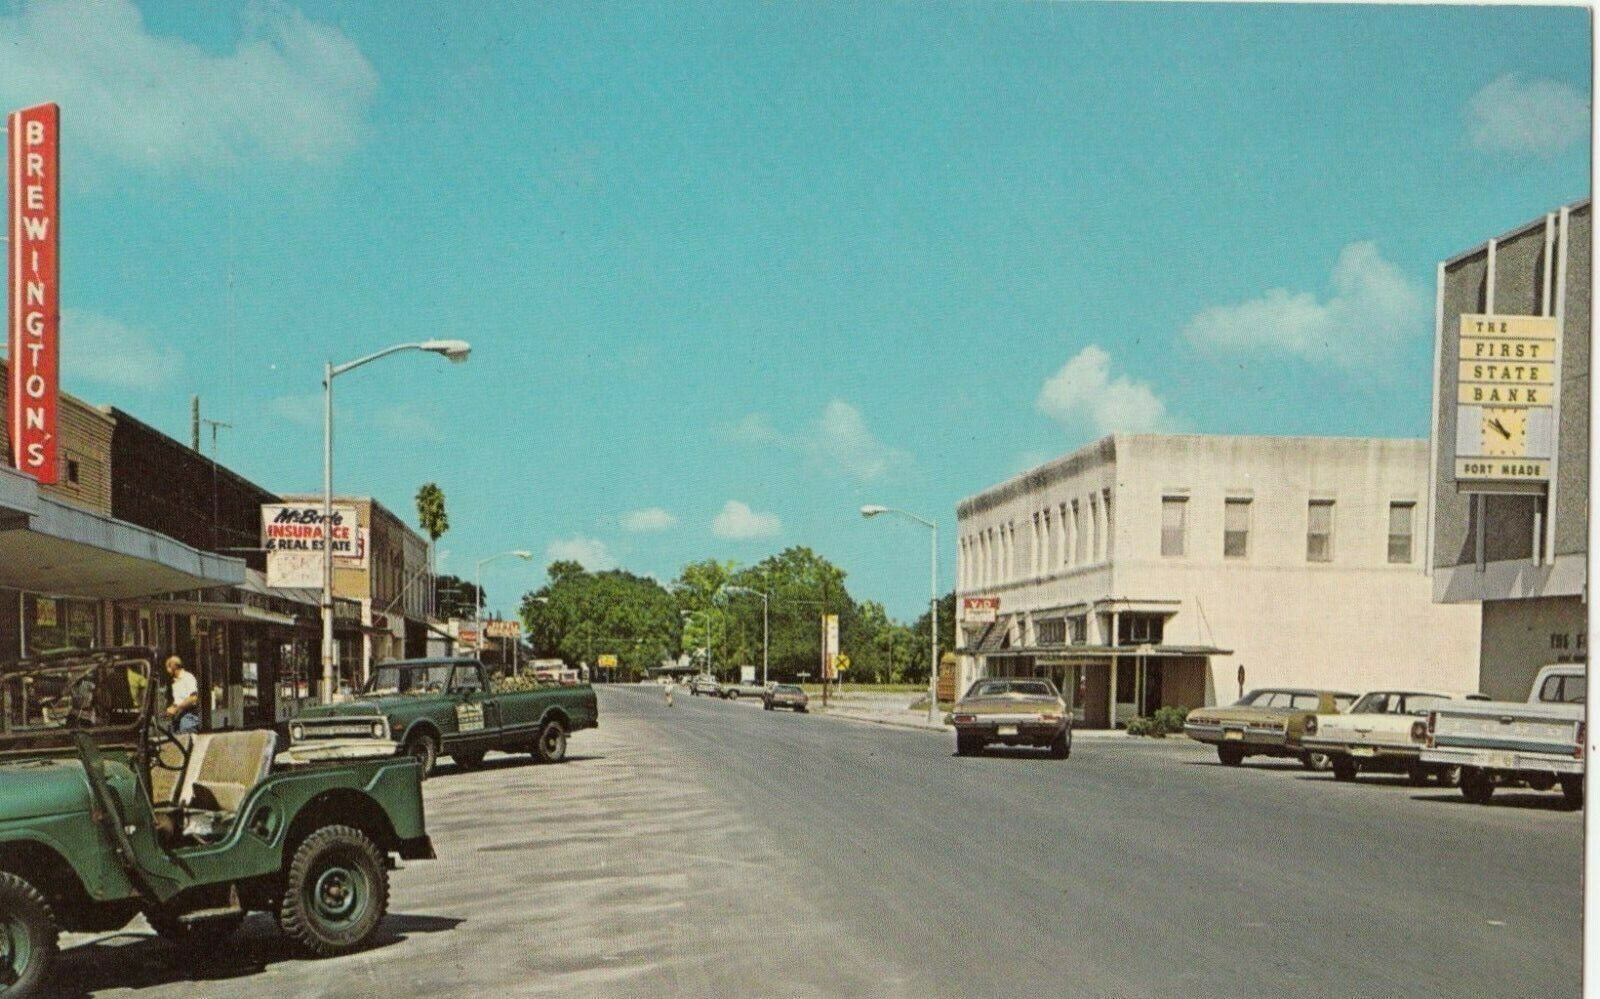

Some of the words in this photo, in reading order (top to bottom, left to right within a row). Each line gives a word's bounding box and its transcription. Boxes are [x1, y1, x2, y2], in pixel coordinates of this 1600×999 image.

[22, 120, 52, 467] BREWINGTON'S
[1476, 321, 1508, 334] THE
[1476, 343, 1540, 358] FIRST
[1474, 365, 1539, 380] STATE
[1474, 387, 1537, 403] BANK
[1464, 464, 1494, 475] FORT
[1501, 464, 1541, 477] MEADE
[267, 525, 349, 539] INSURACE
[279, 539, 308, 550] REAL
[312, 540, 350, 551] ESATE
